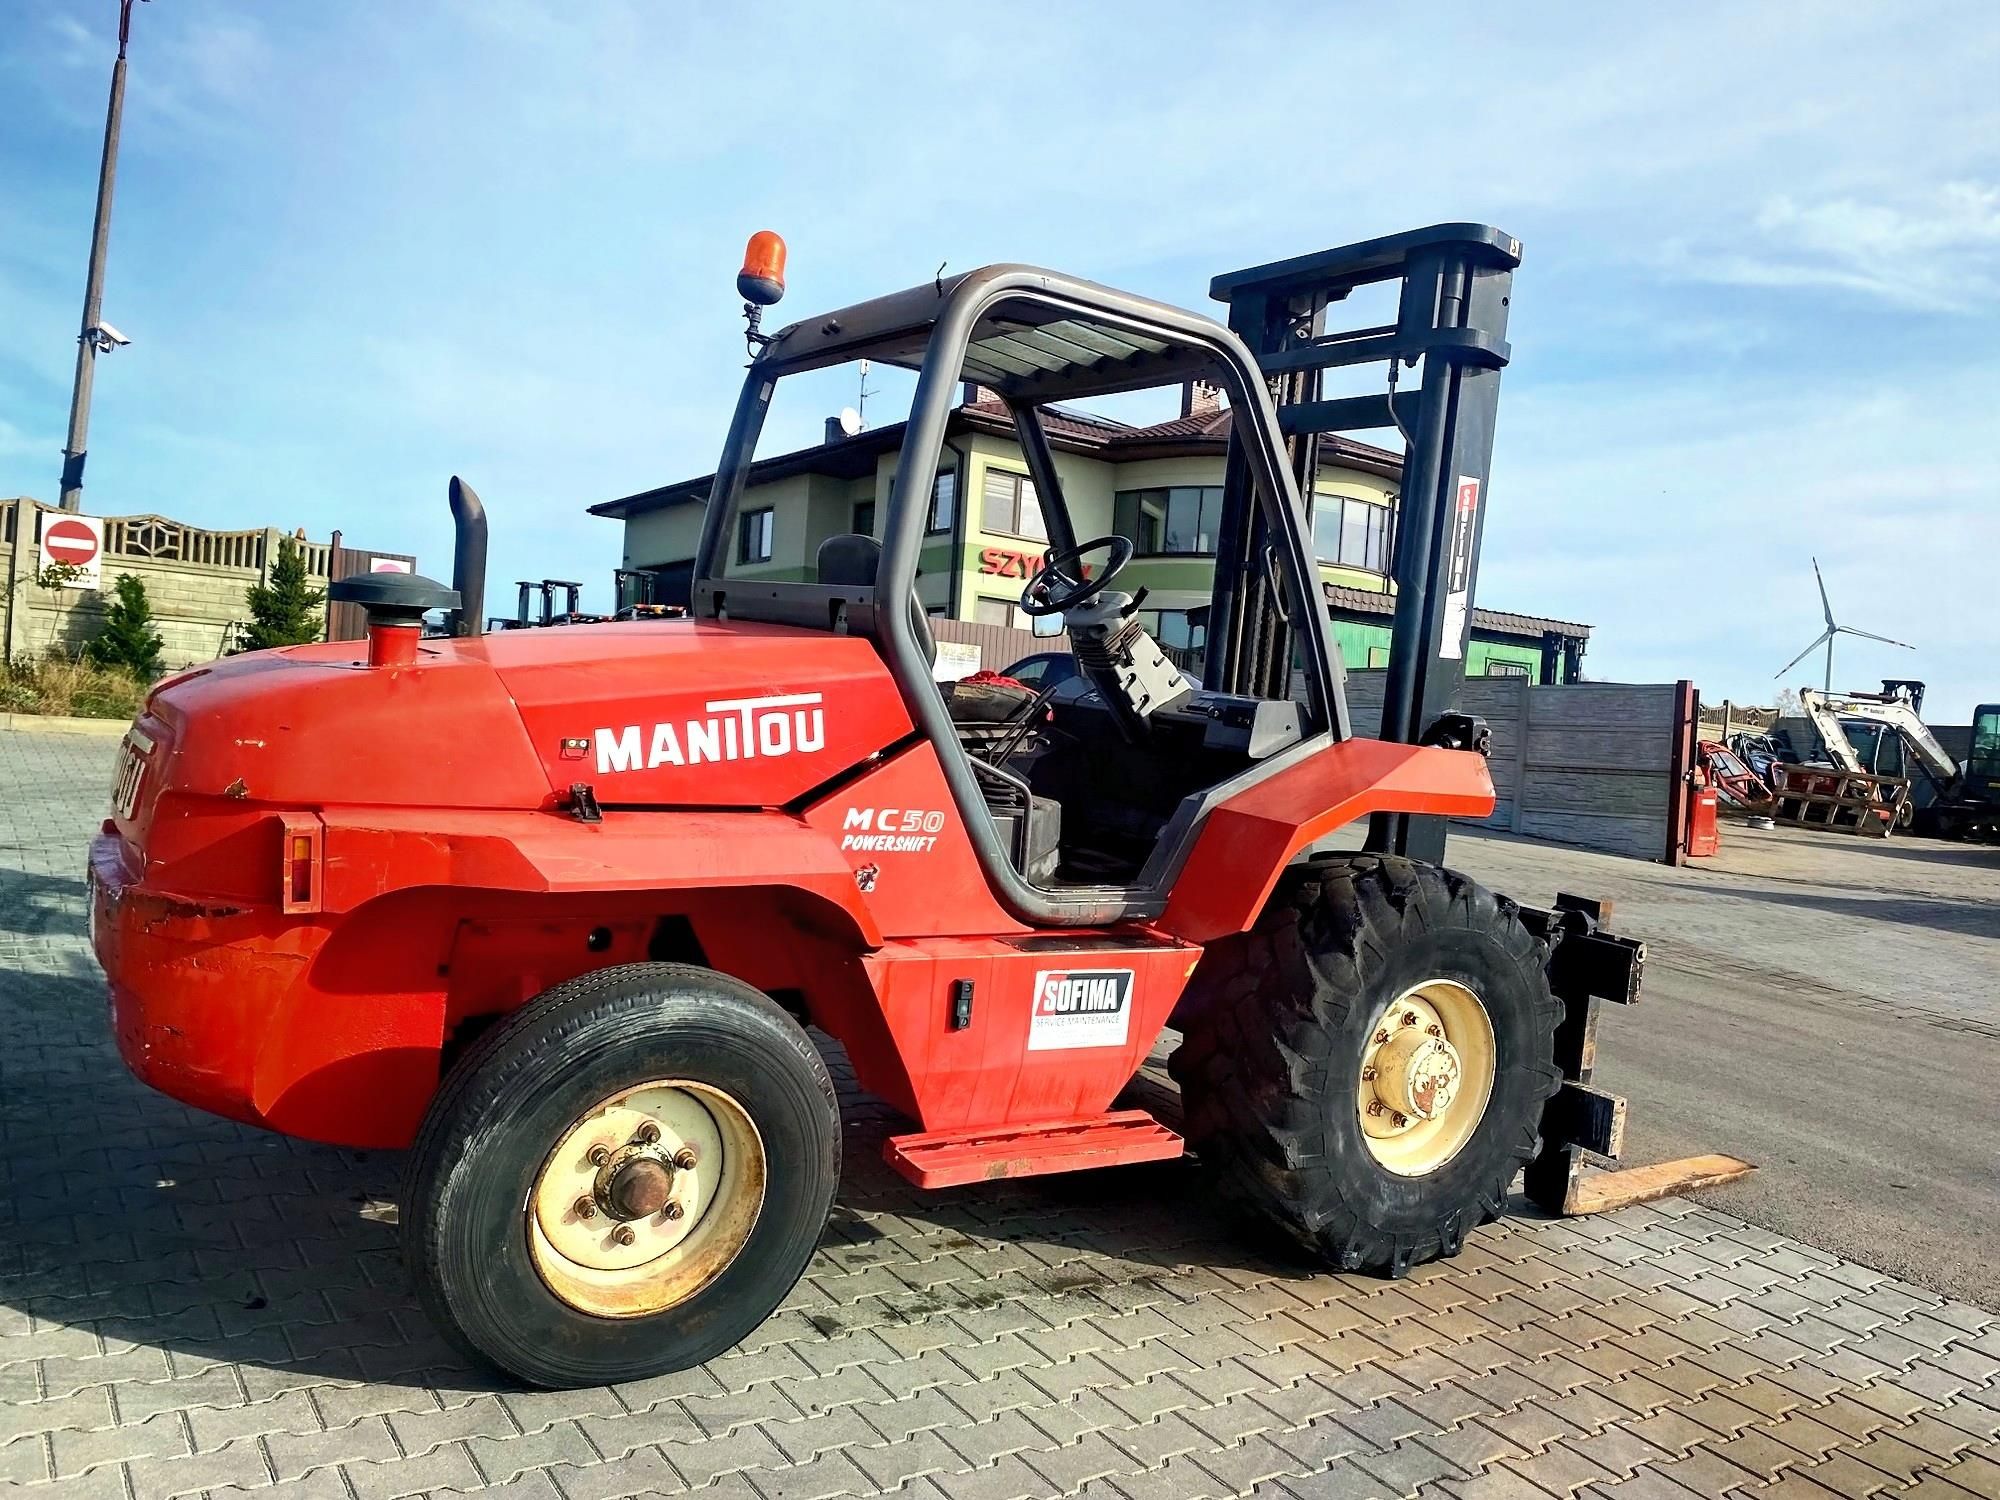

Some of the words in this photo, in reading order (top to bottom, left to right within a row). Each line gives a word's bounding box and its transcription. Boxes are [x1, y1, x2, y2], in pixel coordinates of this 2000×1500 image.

[594, 692, 825, 774] MANITOU
[842, 807, 945, 833] MC50
[841, 834, 938, 852] POWERSHIFT
[1043, 977, 1118, 1012] SOFIMA
